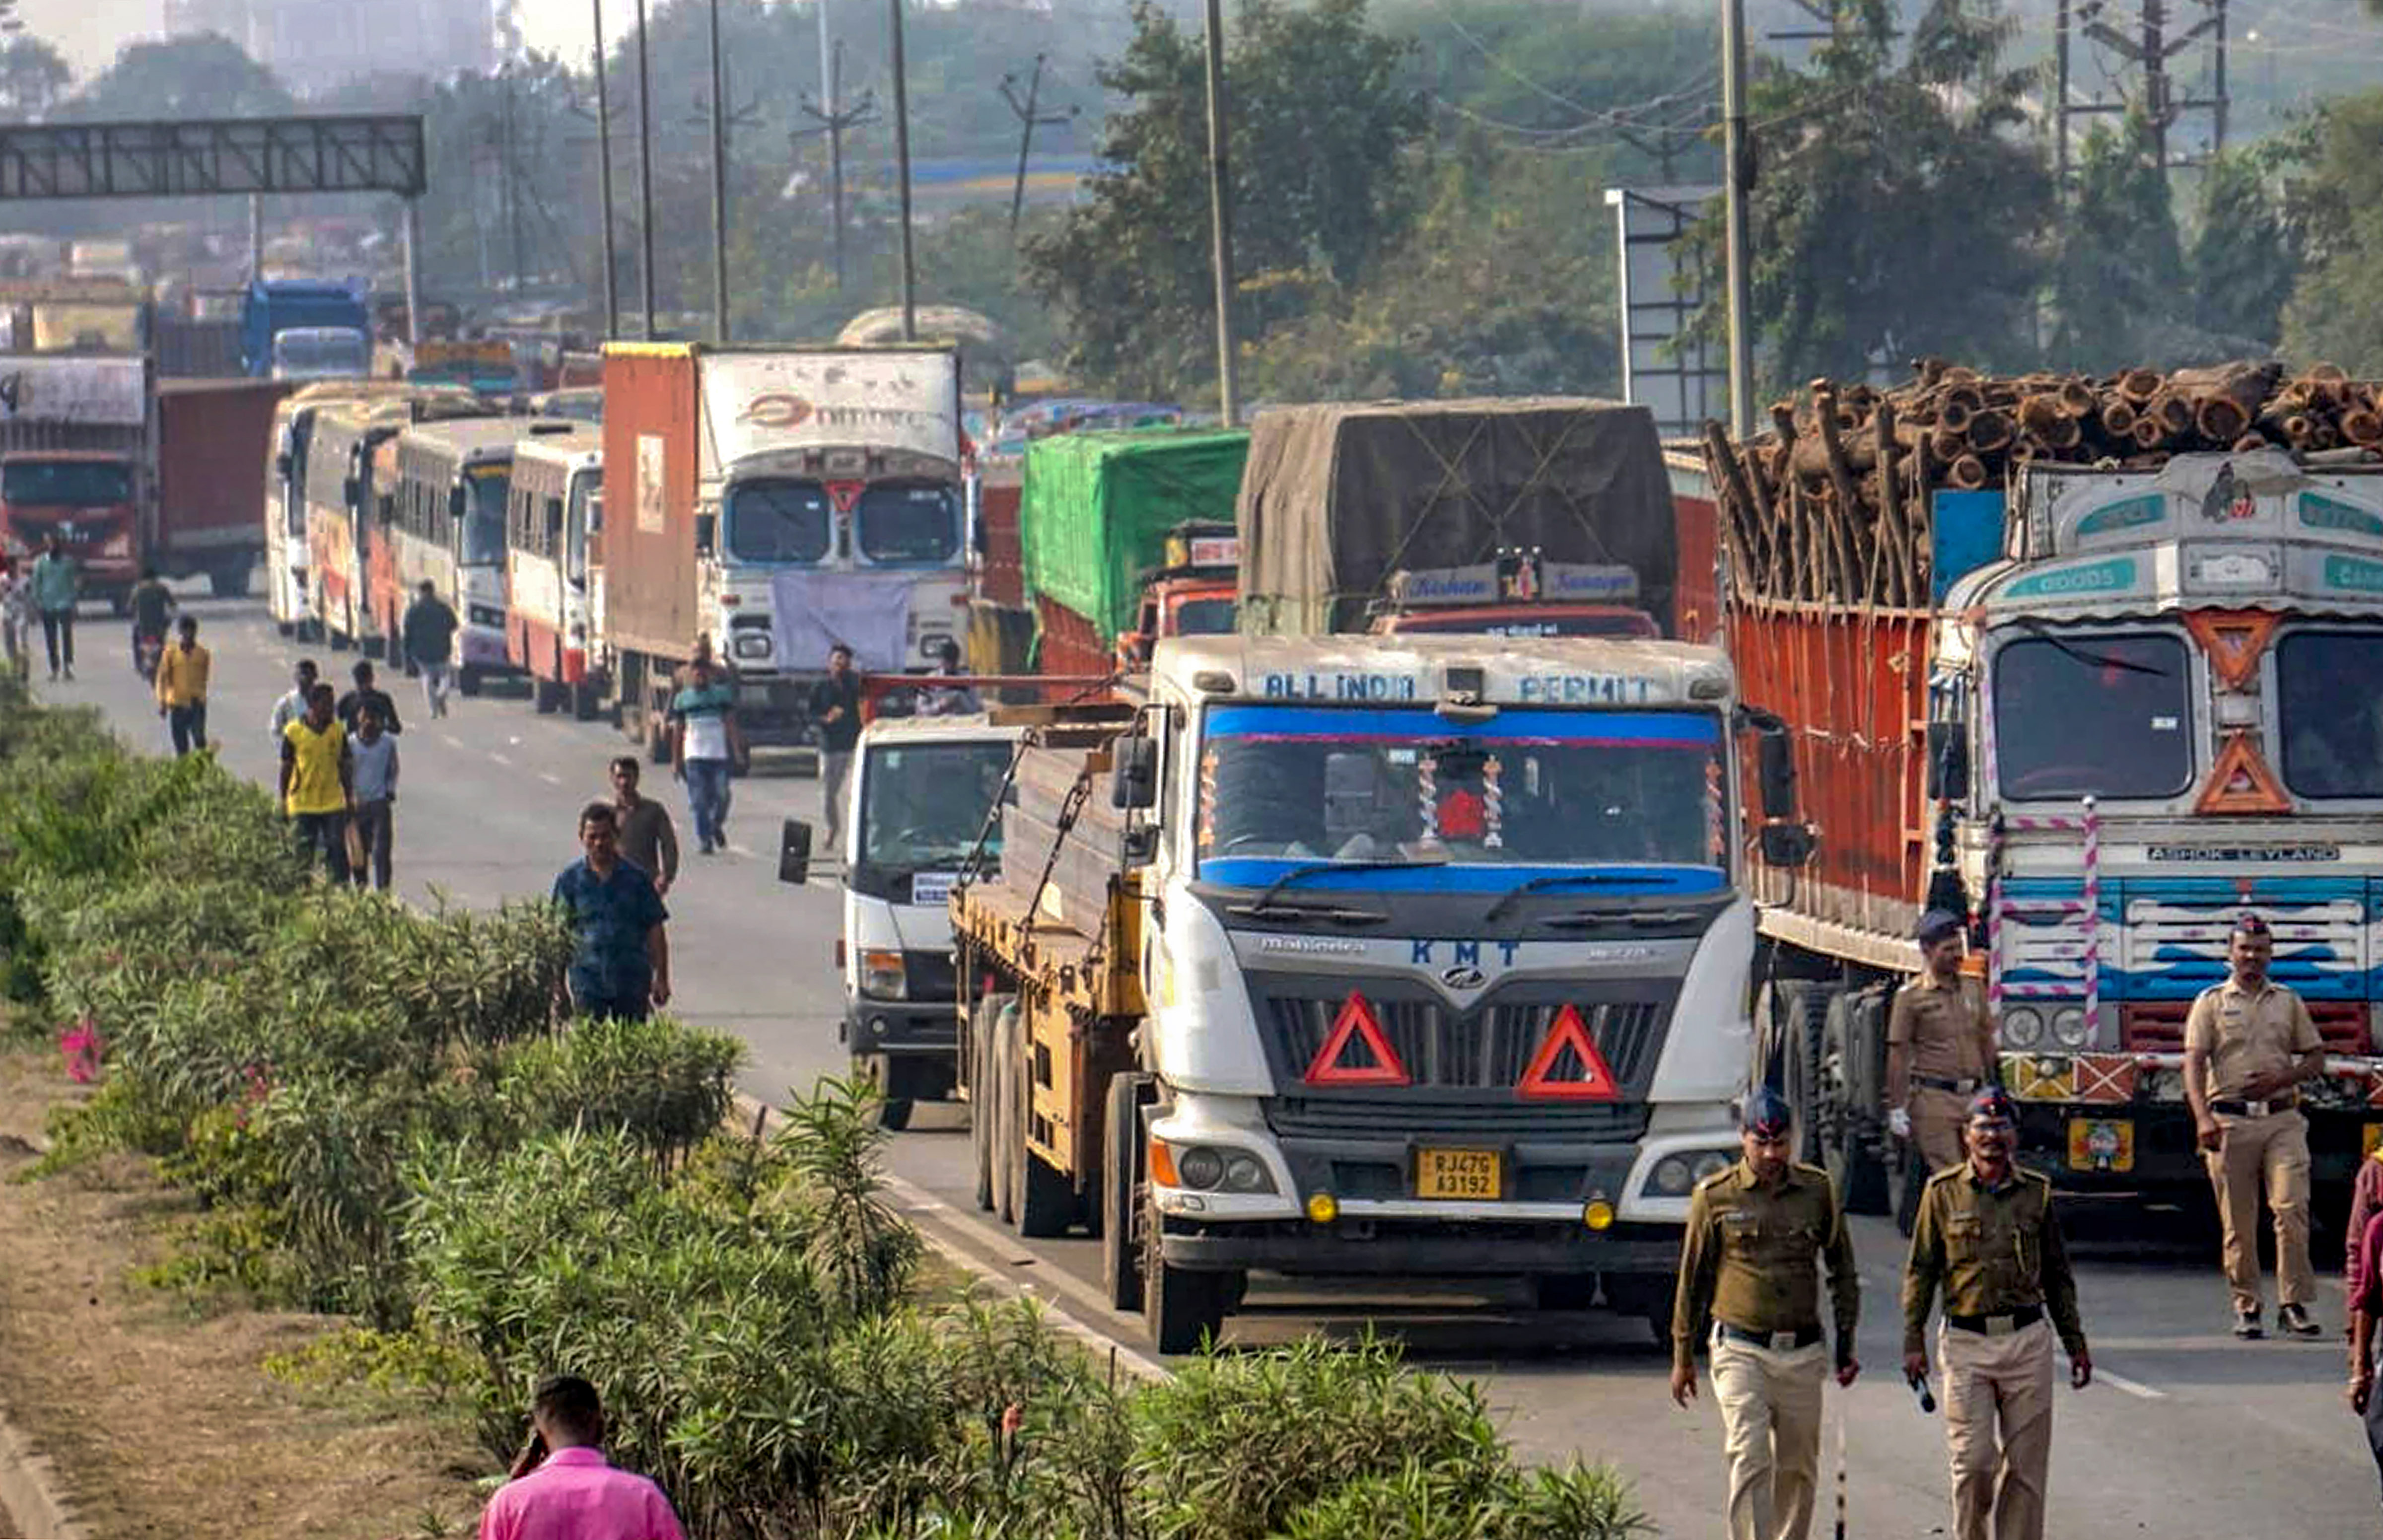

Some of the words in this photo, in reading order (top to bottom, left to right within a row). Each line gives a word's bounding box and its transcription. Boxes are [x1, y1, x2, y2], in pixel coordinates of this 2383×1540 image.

[1266, 674, 1324, 698] ALL
[1520, 675, 1654, 701] PERMIT
[2152, 847, 2221, 860] ASHOK
[2238, 847, 2339, 860] LEYLAND
